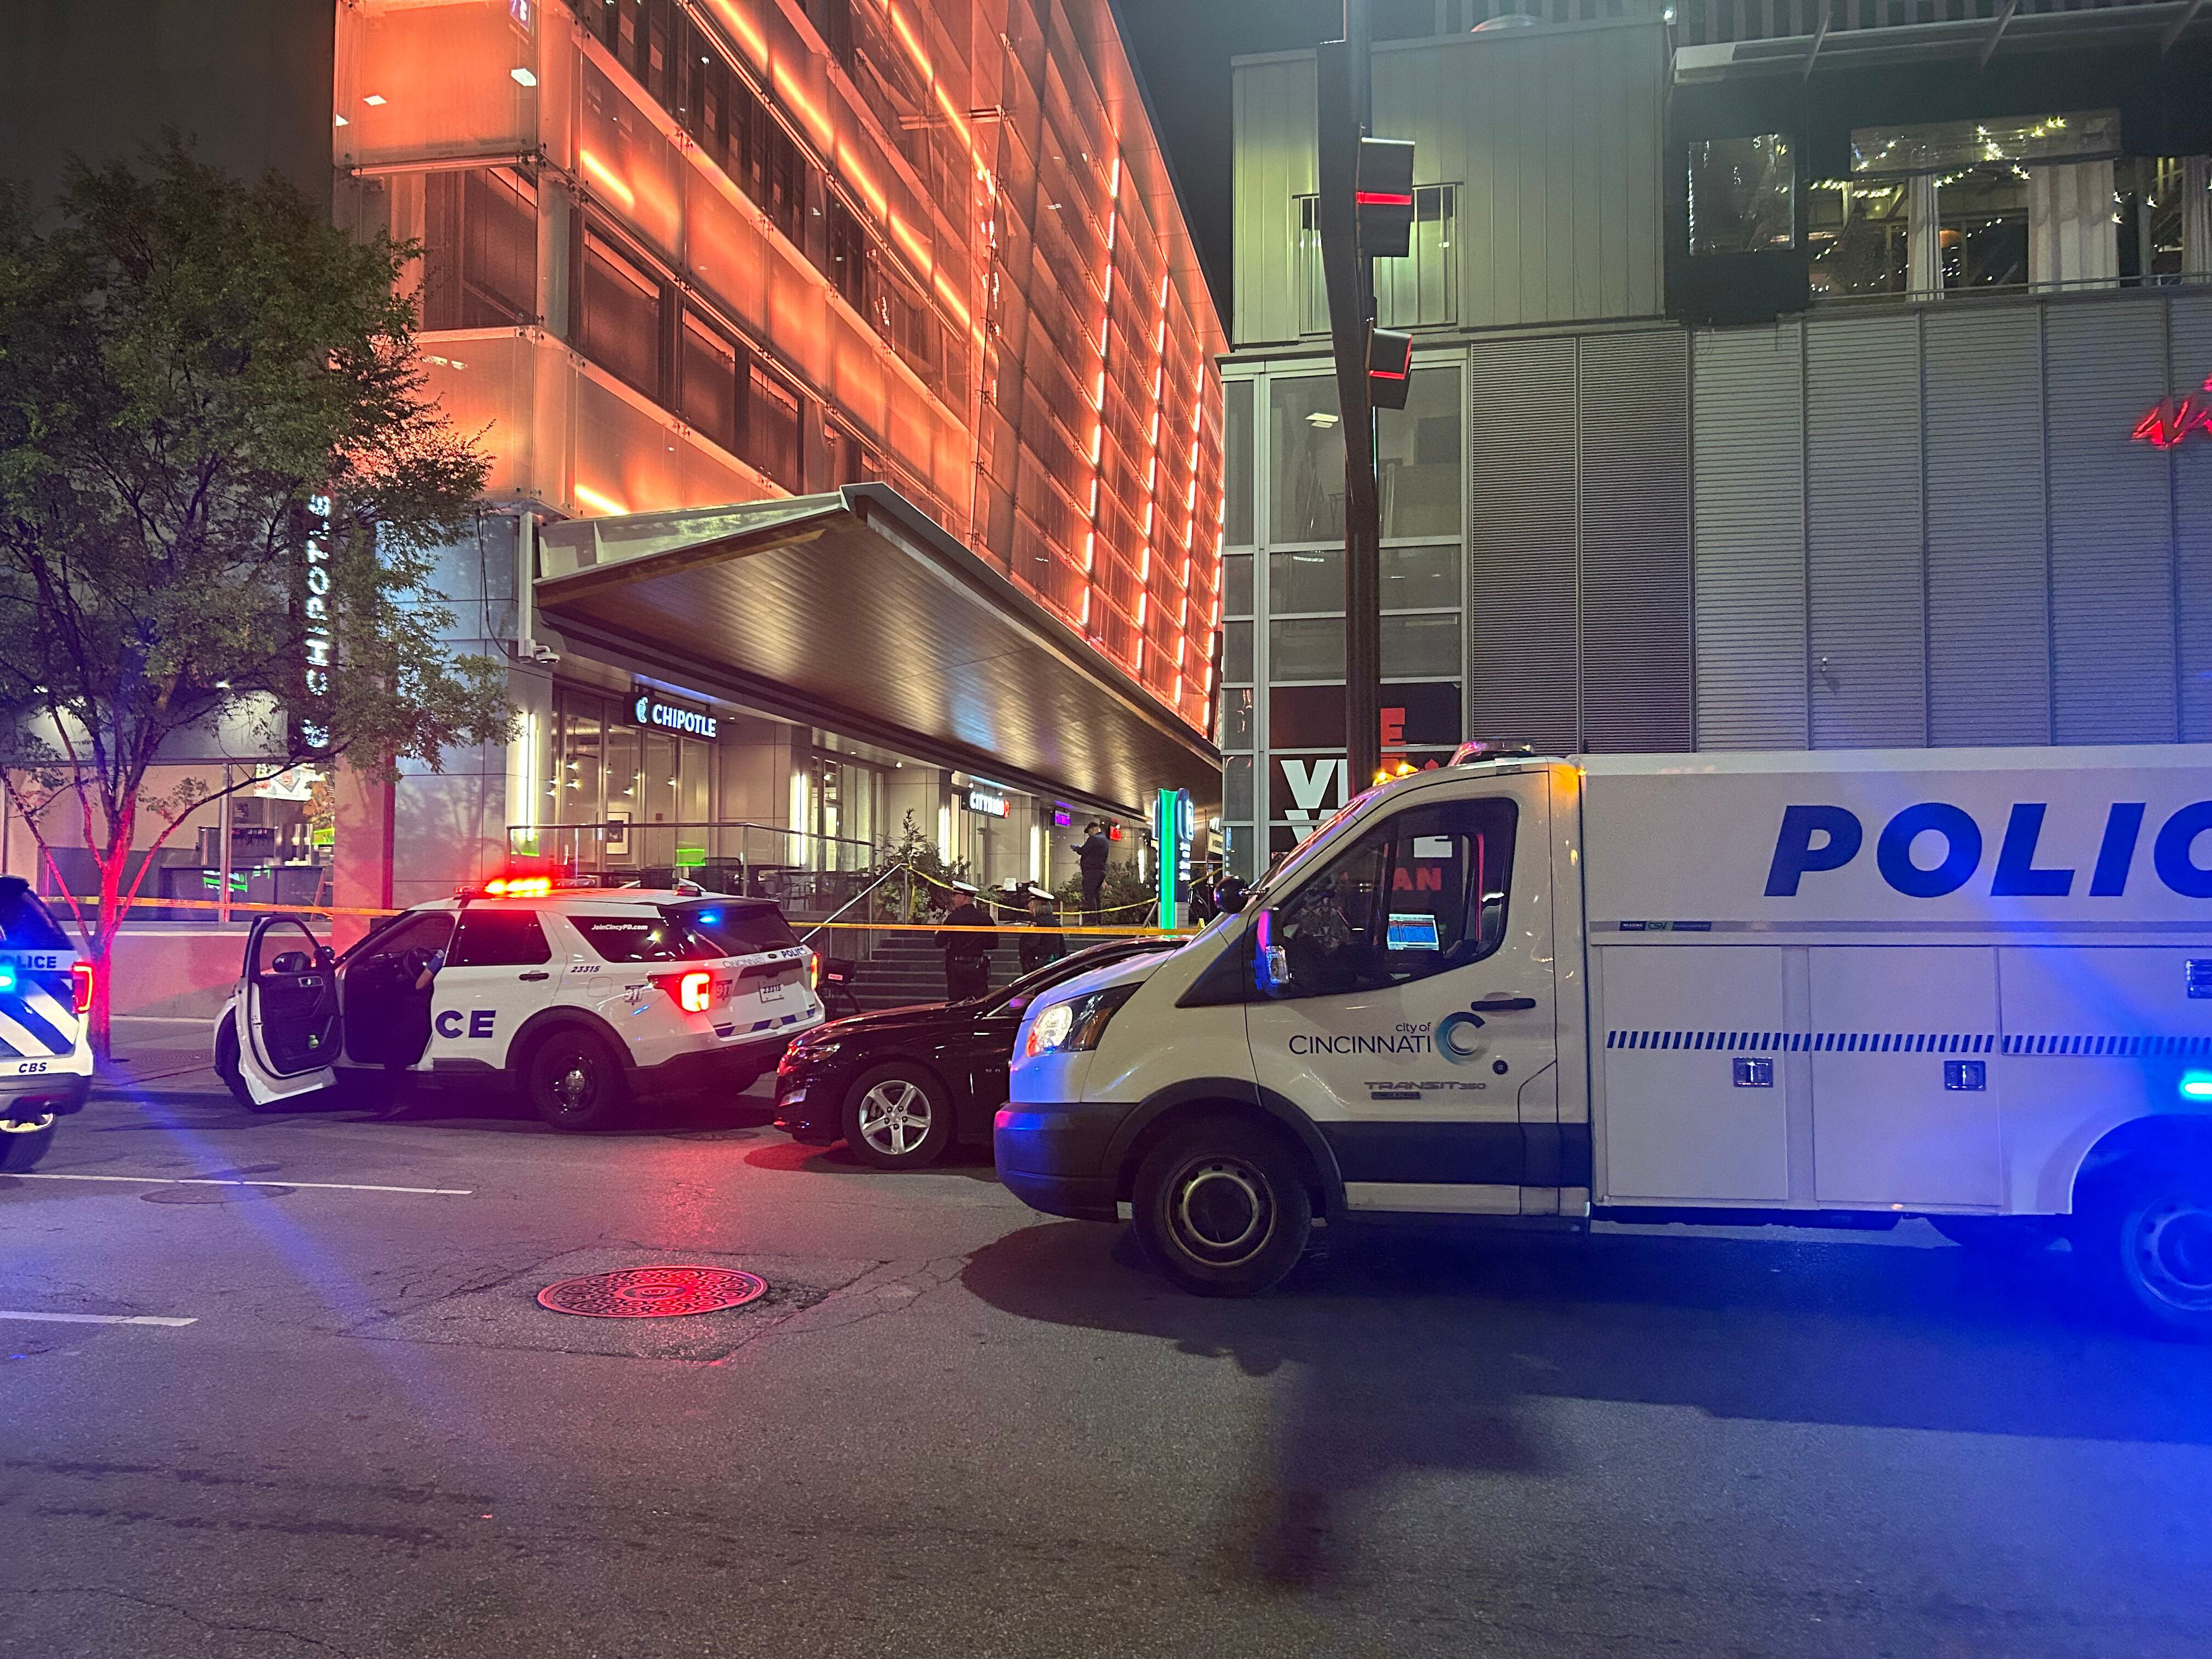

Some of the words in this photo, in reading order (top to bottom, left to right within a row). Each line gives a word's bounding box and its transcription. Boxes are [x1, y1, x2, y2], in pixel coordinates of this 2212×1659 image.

[652, 704, 717, 737] CHIPOTLE
[723, 957, 765, 968] CINCINNATI
[624, 988, 643, 1000] 911
[763, 985, 782, 994] 23315
[435, 1010, 497, 1039] CE
[1396, 1023, 1417, 1034] city
[1419, 1022, 1432, 1032] of
[1289, 1035, 1432, 1055] CINCINNATI
[19, 1062, 47, 1073] CBS
